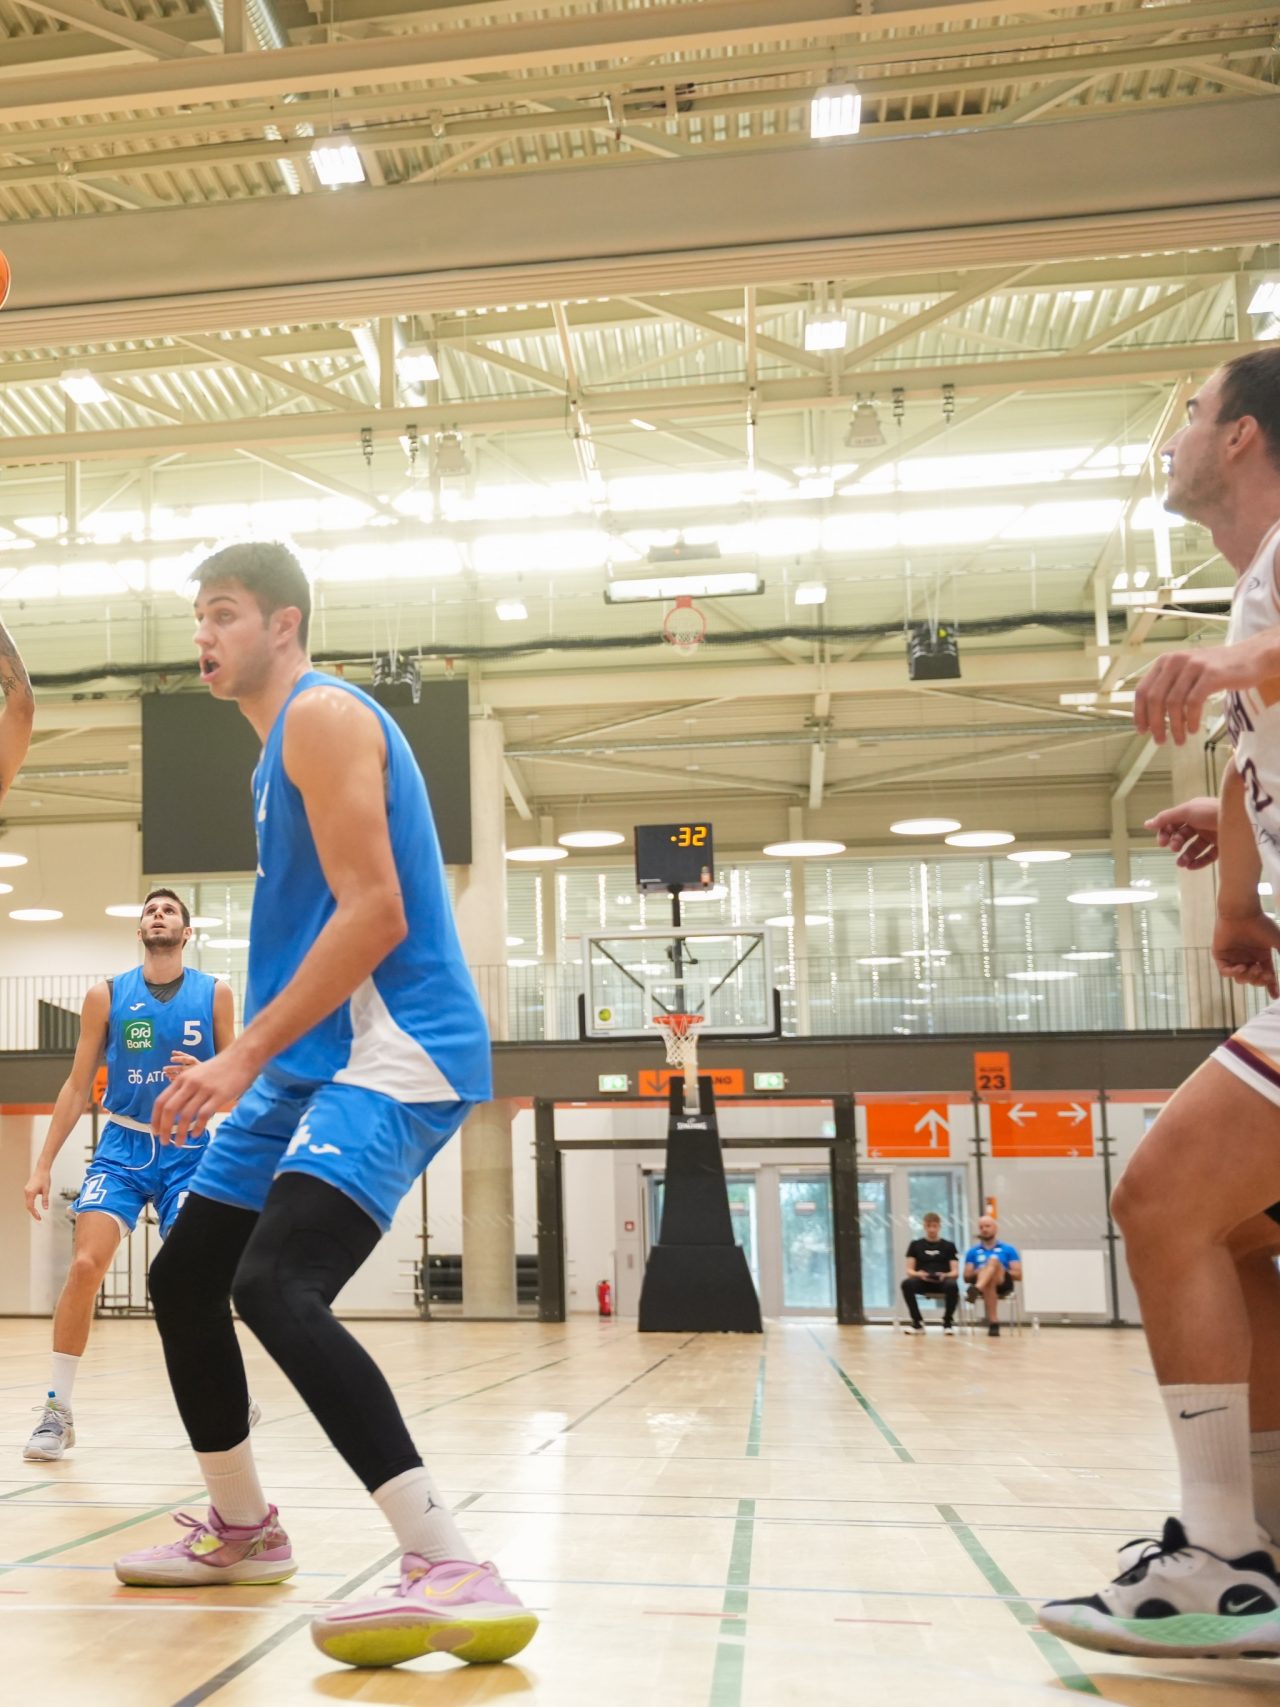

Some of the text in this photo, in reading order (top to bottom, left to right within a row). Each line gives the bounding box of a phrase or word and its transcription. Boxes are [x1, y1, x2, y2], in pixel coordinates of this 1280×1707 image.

[182, 1020, 203, 1046] 5
[126, 1039, 152, 1049] Bank
[979, 1075, 1007, 1089] 23
